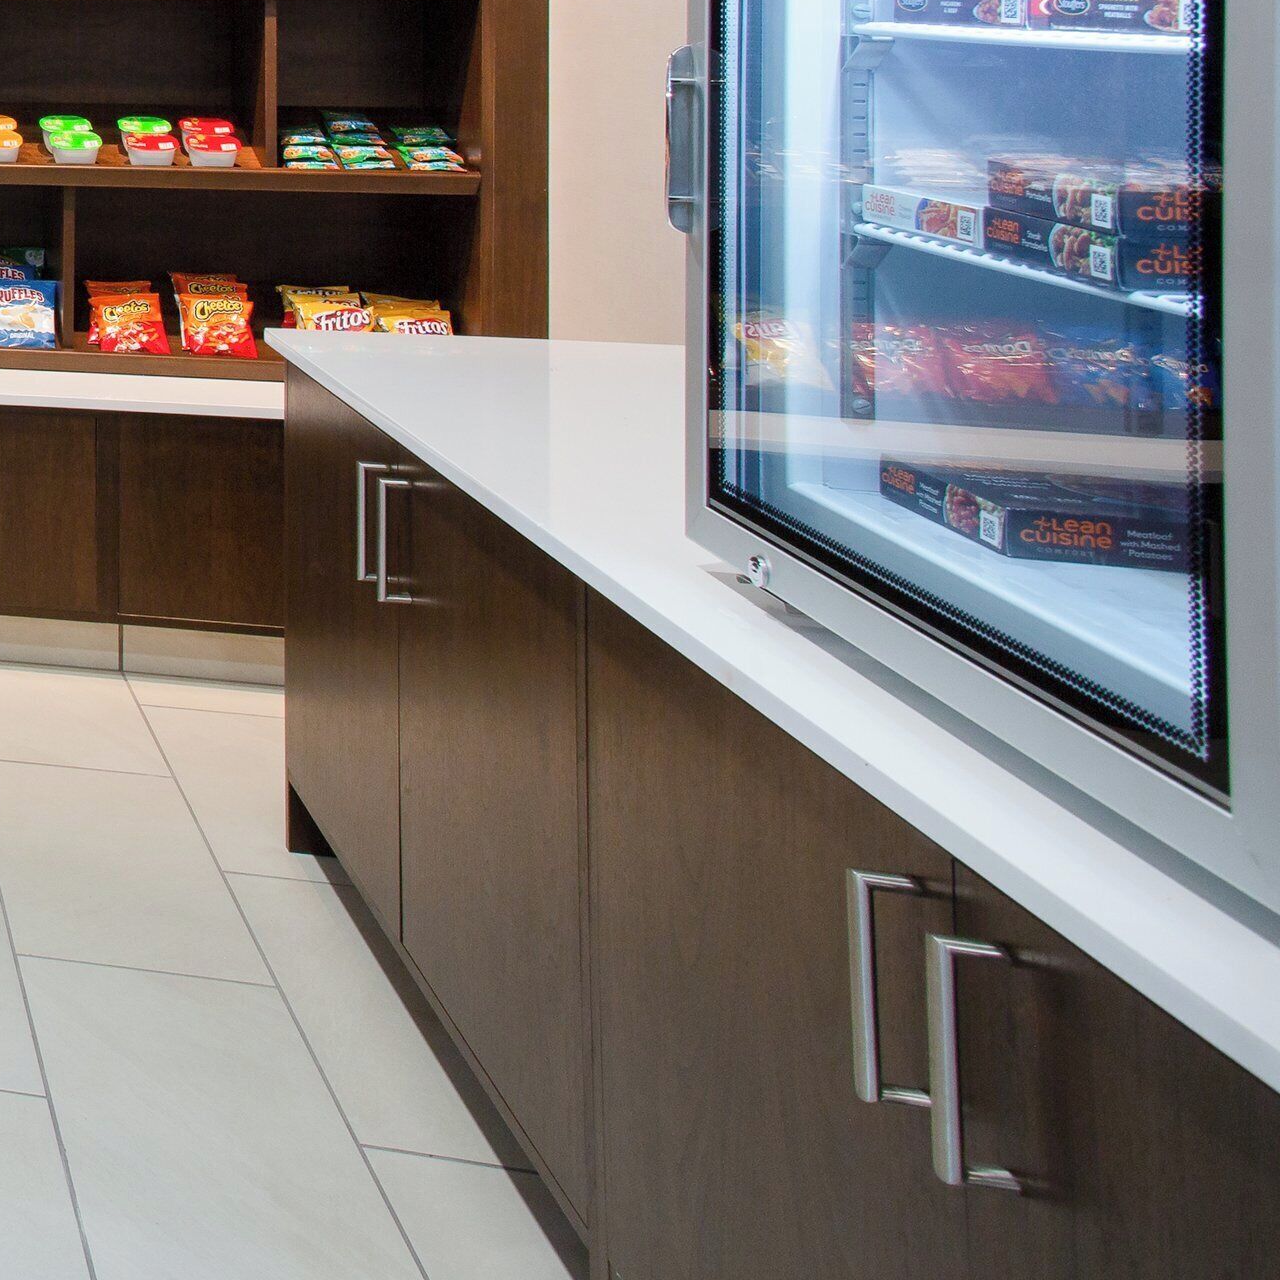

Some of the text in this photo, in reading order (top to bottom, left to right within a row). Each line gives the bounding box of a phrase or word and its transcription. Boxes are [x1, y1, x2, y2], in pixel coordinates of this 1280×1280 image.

[104, 300, 150, 321] Cheetos
[195, 299, 244, 321] Cheetos
[313, 307, 371, 332] Fritos
[1127, 528, 1173, 541] Meatloaf
[1140, 540, 1181, 552] Mashed
[1129, 549, 1173, 561] Potatoes
